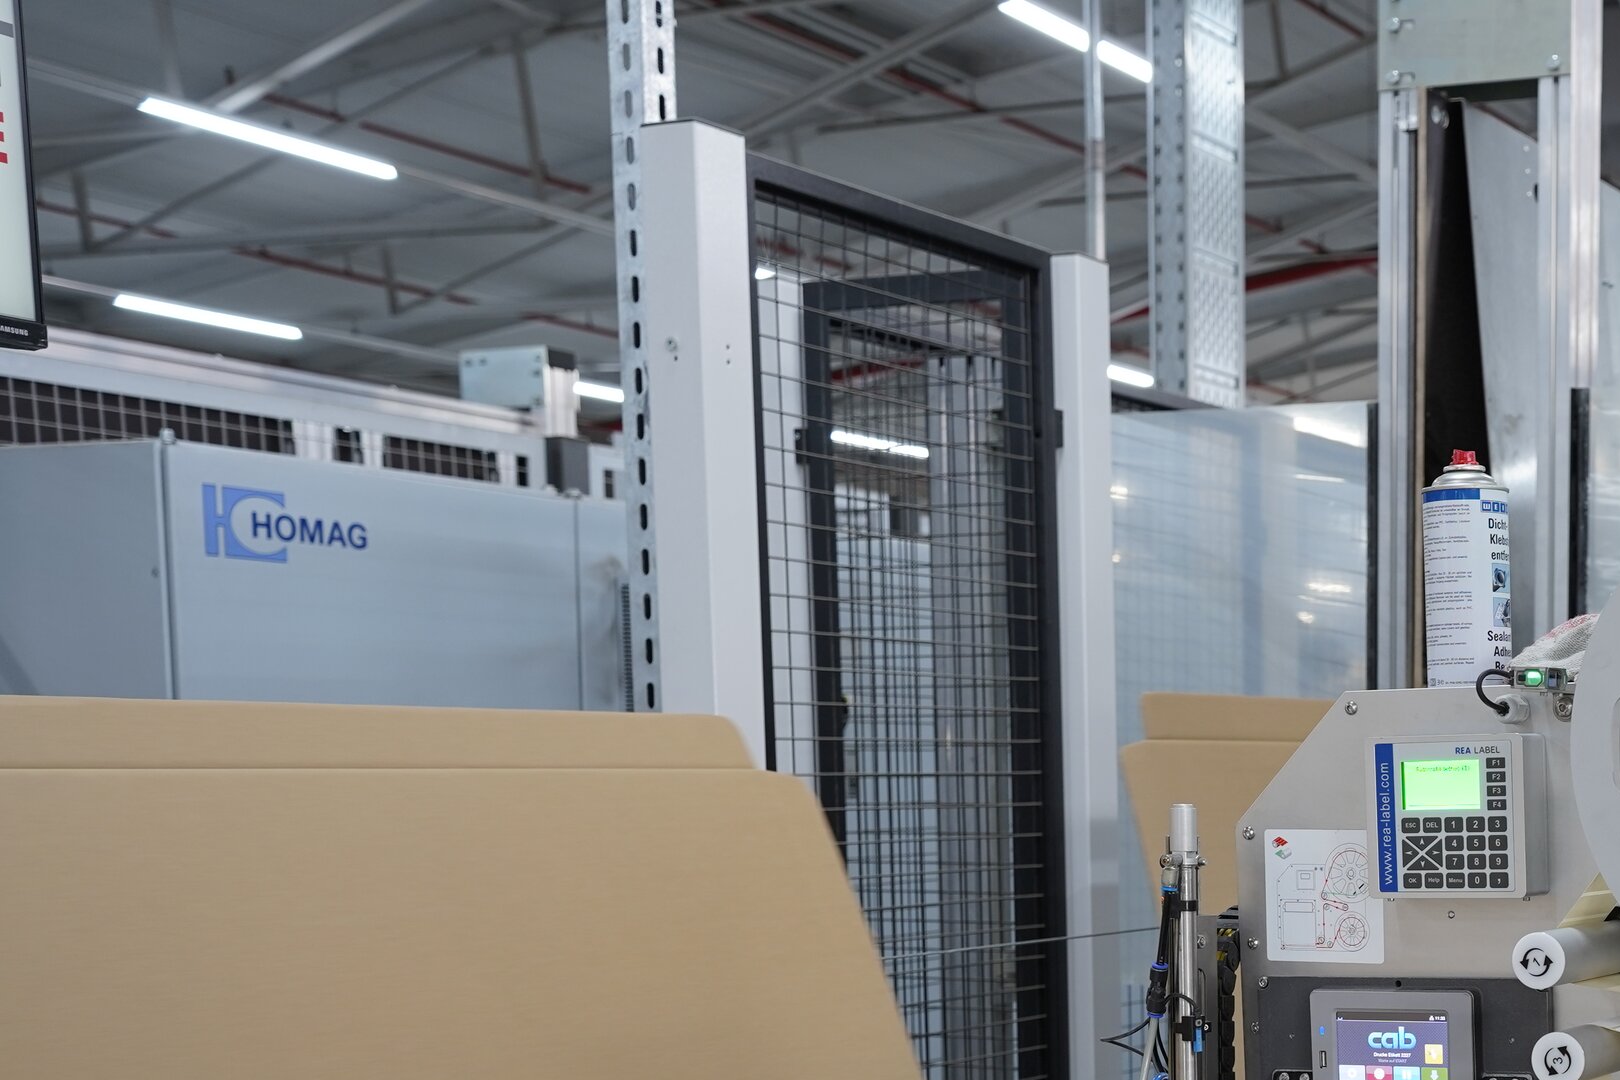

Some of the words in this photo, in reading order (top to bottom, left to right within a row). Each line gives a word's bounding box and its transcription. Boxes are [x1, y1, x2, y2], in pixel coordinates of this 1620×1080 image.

[0, 325, 28, 336] AMSUNG
[252, 510, 368, 550] HOMAG
[1474, 746, 1500, 754] LABEL
[1380, 762, 1393, 885] www.rea-label.com
[1495, 820, 1500, 828] 3
[1473, 839, 1478, 847] 5
[1452, 858, 1458, 866] 7
[1474, 876, 1480, 884] 0
[1368, 1026, 1417, 1049] cab
